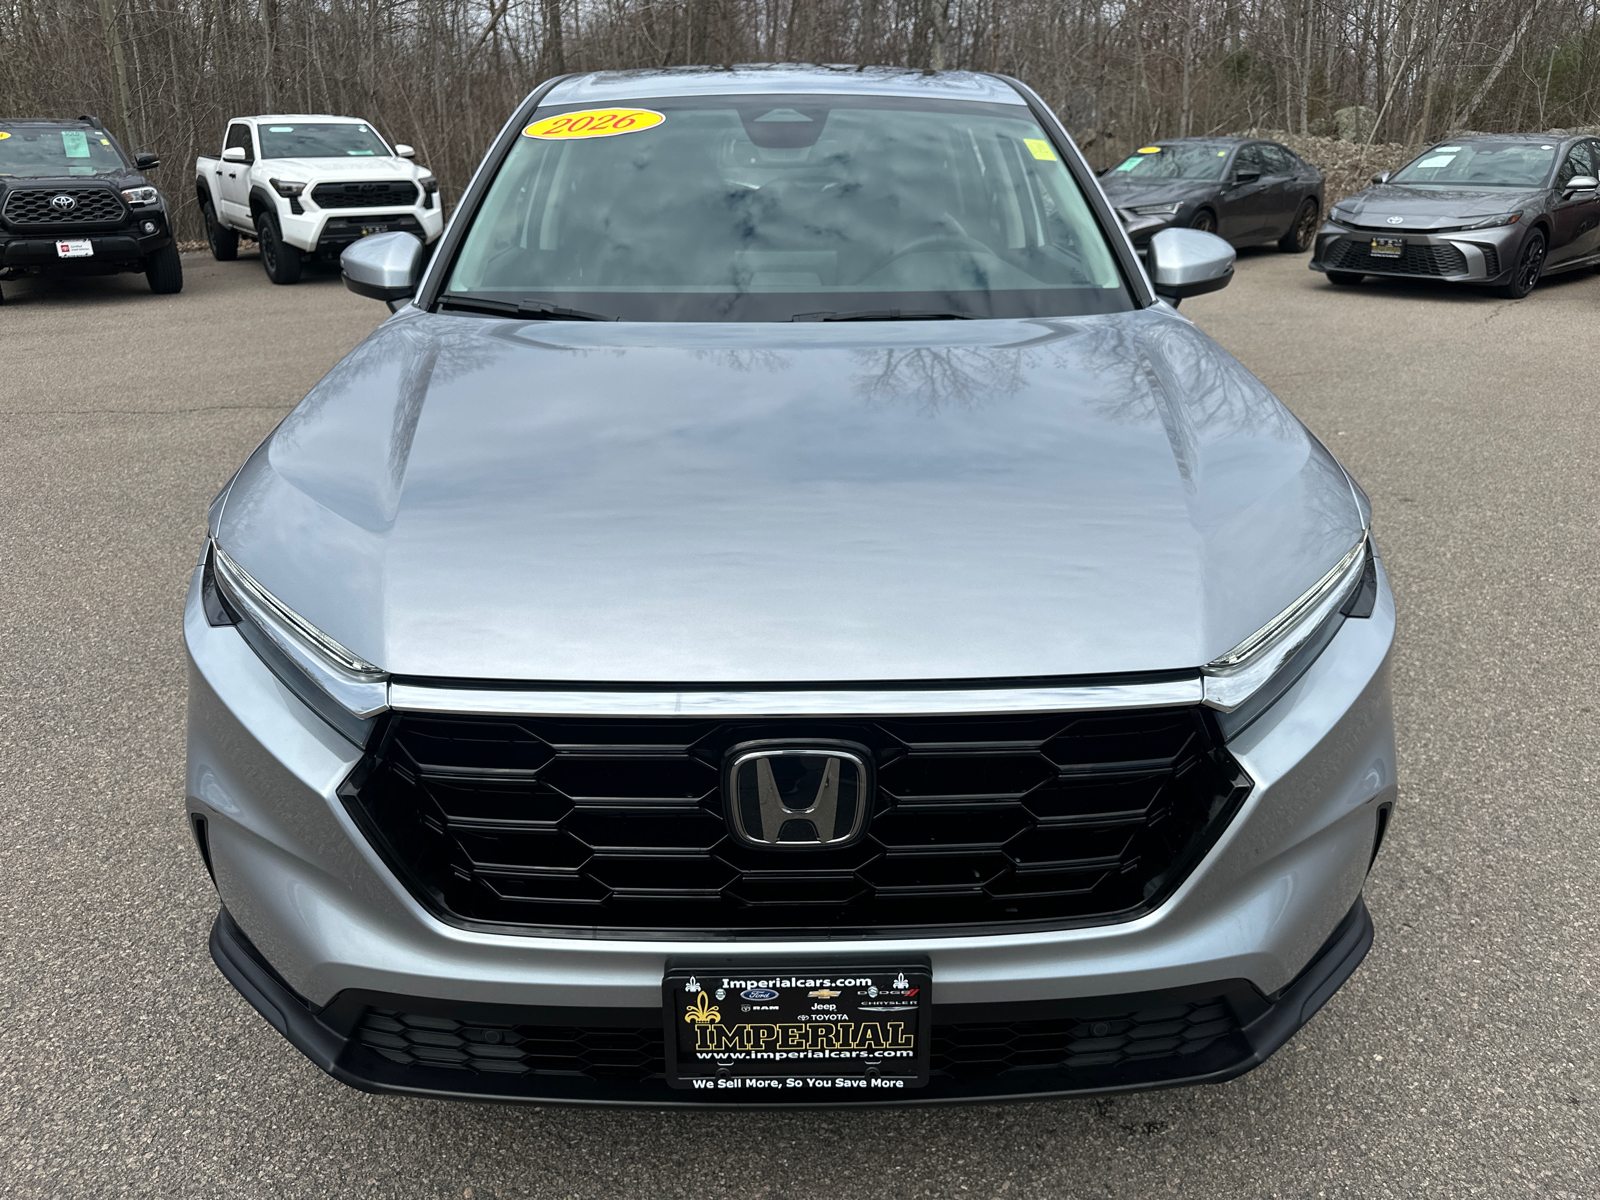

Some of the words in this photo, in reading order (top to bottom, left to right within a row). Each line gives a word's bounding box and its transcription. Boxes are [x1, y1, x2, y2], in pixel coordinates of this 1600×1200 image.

[542, 113, 644, 135] 2026
[722, 977, 872, 990] Imperialcars.com
[748, 991, 770, 999] Ford
[811, 1003, 836, 1012] Jeep
[695, 1022, 914, 1050] IMPERIAL
[696, 1049, 914, 1060] www.imperialcars.com
[692, 1079, 714, 1089] We
[717, 1079, 742, 1089] Sell
[745, 1078, 782, 1089] More,
[786, 1078, 803, 1088] So
[806, 1078, 832, 1088] You
[835, 1078, 867, 1088] Save
[870, 1078, 904, 1088] More
